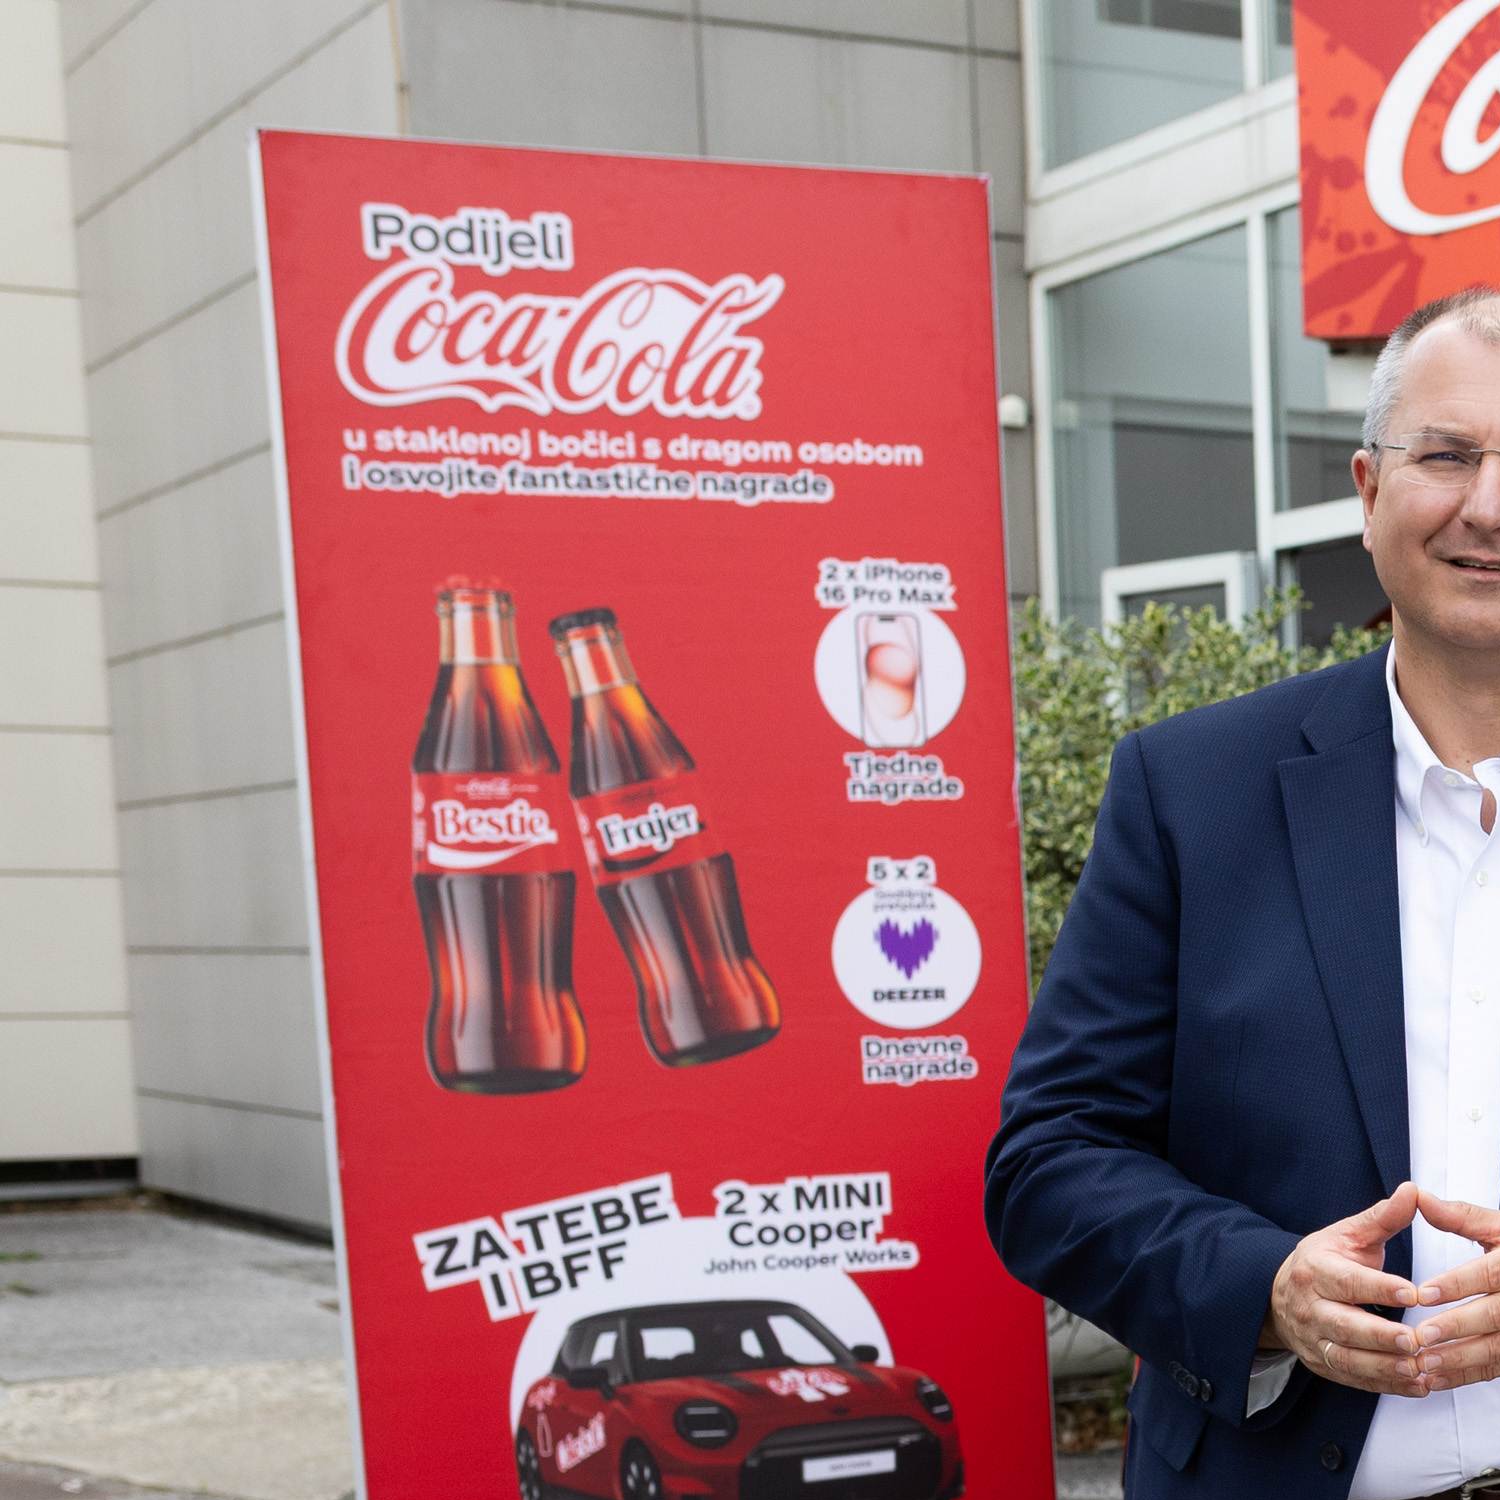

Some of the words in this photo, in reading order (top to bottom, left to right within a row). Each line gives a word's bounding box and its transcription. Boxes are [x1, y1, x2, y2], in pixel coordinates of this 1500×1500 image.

[370, 212, 565, 266] Podijeli
[342, 263, 780, 415] Coca-Cola
[344, 429, 366, 451] u
[374, 427, 532, 461] staklenoj
[538, 428, 636, 458] bočici
[642, 437, 662, 460] s
[668, 434, 792, 466] dragom
[798, 438, 924, 467] osobom
[366, 464, 498, 491] osvojite
[507, 465, 691, 493] fantastične
[701, 469, 828, 499] nagrade
[865, 562, 945, 582] iPhone
[822, 586, 845, 602] 16
[853, 586, 891, 604] Pro
[899, 586, 946, 604] Max
[849, 756, 939, 779] Tjedne
[851, 779, 959, 800] nagrade
[438, 802, 546, 838] Bestie
[602, 806, 695, 850] Frajer
[872, 862, 888, 881] 5
[915, 861, 930, 880] 2
[872, 987, 946, 1003] DEEZER
[865, 1039, 963, 1058] Dnevne
[866, 1057, 975, 1081] nagrade
[723, 1188, 748, 1216] 2
[759, 1191, 781, 1214] x
[794, 1180, 885, 1212] MINI
[426, 1228, 509, 1277] ZA
[515, 1185, 670, 1251] TEBE
[728, 1218, 876, 1249] Cooper
[489, 1272, 508, 1308] I
[521, 1240, 628, 1300] BFF
[704, 1256, 758, 1275] John
[762, 1252, 839, 1271] Cooper
[846, 1247, 913, 1264] Works
